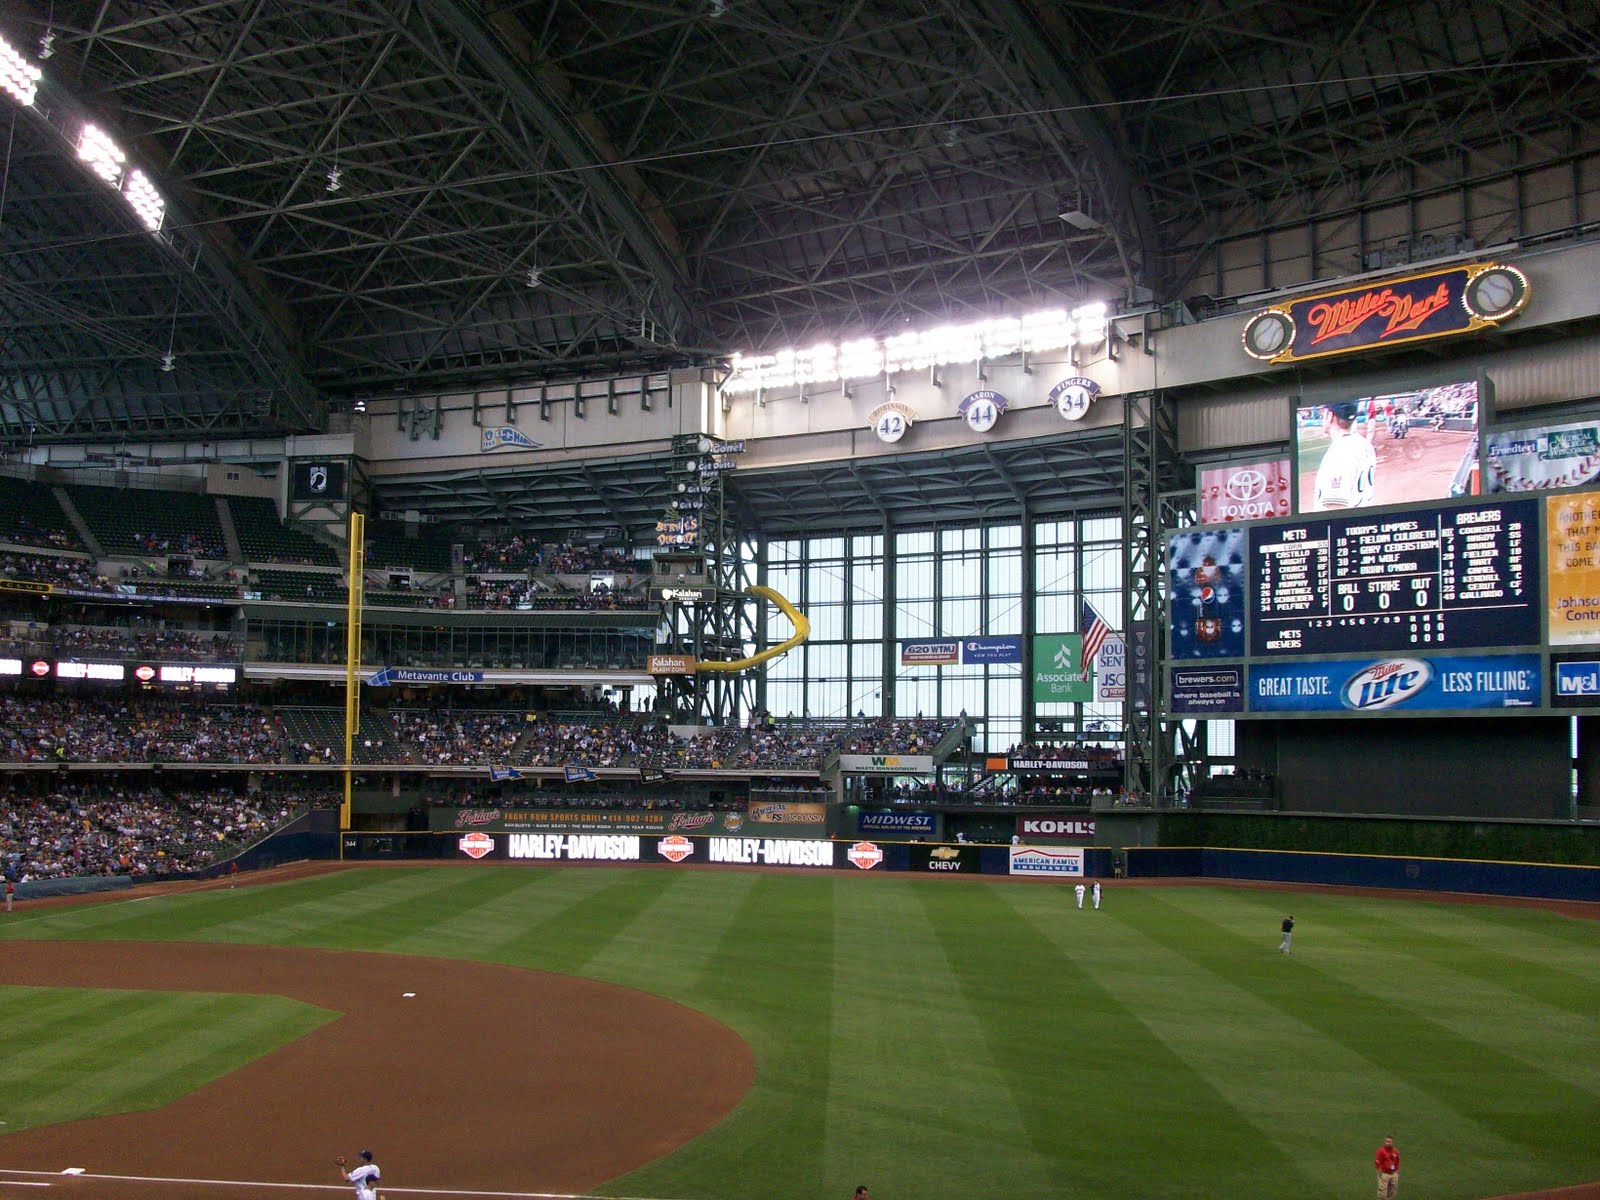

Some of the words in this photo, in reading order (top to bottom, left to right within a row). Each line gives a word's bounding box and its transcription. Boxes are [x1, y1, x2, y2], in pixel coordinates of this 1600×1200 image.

[1307, 288, 1394, 344] Miller
[1379, 283, 1449, 338] Park
[1056, 379, 1092, 393] FINGERS
[968, 391, 996, 402] AARON
[1062, 393, 1085, 412] 34
[970, 406, 992, 424] 44
[880, 417, 901, 435] 42
[713, 443, 743, 453] Gone!
[1491, 443, 1536, 455] Froedtert
[698, 463, 712, 471] Get
[713, 461, 735, 470] Outta
[1220, 501, 1275, 518] TOYOTA
[1456, 510, 1501, 525] BREWERS
[1558, 511, 1600, 522] ANOTHE
[1381, 521, 1418, 533] UMPIRES
[1567, 527, 1590, 537] THAT
[1282, 529, 1307, 541] METS
[1557, 542, 1581, 553] THIS
[1275, 550, 1310, 559] CASTILLO
[1360, 556, 1375, 565] JIM
[1378, 553, 1401, 563] WOLF
[1566, 557, 1593, 568] COME
[1337, 583, 1360, 595] BALL
[1367, 580, 1401, 593] STRIKE
[1411, 577, 1432, 590] OUT
[672, 588, 703, 598] Kalahari
[1343, 594, 1354, 611] 0
[1378, 592, 1390, 609] 0
[1415, 590, 1428, 607] 0
[1557, 596, 1600, 609] Johnso
[1308, 620, 1313, 628] 1
[1315, 620, 1322, 628] 2
[1325, 619, 1332, 627] 3
[1349, 618, 1356, 626] 5
[1279, 630, 1302, 639] METS
[1410, 623, 1417, 633] 0
[1423, 622, 1431, 632] 0
[1437, 621, 1445, 631] 0
[1266, 639, 1302, 650] BREWERS
[1410, 633, 1417, 643] 0
[1423, 632, 1431, 642] 0
[1437, 632, 1445, 642] 0
[908, 646, 930, 654] 620
[930, 645, 956, 653] WTMJ
[967, 642, 1016, 653] Champion
[1100, 644, 1125, 656] JOU
[652, 657, 686, 667] Kalahari
[1136, 632, 1146, 683] VOTE
[398, 670, 449, 681] Metavante
[452, 671, 475, 681] Club
[1367, 662, 1405, 680] Miller
[1178, 674, 1236, 684] brewers.com
[1442, 671, 1473, 693] LESS
[1050, 683, 1073, 694] Bank
[1259, 678, 1292, 696] GREAT
[1296, 676, 1332, 696] TASTE.
[1358, 667, 1420, 708] Lite
[1199, 691, 1231, 699] baseball
[1188, 698, 1214, 706] always
[871, 757, 900, 766] WM
[1013, 760, 1089, 769] HARLEY-DAVIDSON
[455, 808, 501, 828] Friday's
[504, 812, 527, 821] FRONT
[530, 813, 548, 821] ROW
[550, 813, 579, 821] SPORTS
[581, 814, 600, 822] GRILL
[668, 811, 715, 831] Friday's
[784, 814, 826, 822] WISCONSIN
[863, 815, 932, 826] MIDWEST
[1024, 820, 1095, 834] KOHL'S
[509, 834, 640, 860] HARLEY-DAVIDSON
[709, 838, 834, 866] HARLEY-DAVIDSON
[929, 860, 961, 871] CHEVY
[1013, 857, 1050, 865] AMERICAN
[1052, 858, 1079, 866] FAMILY
